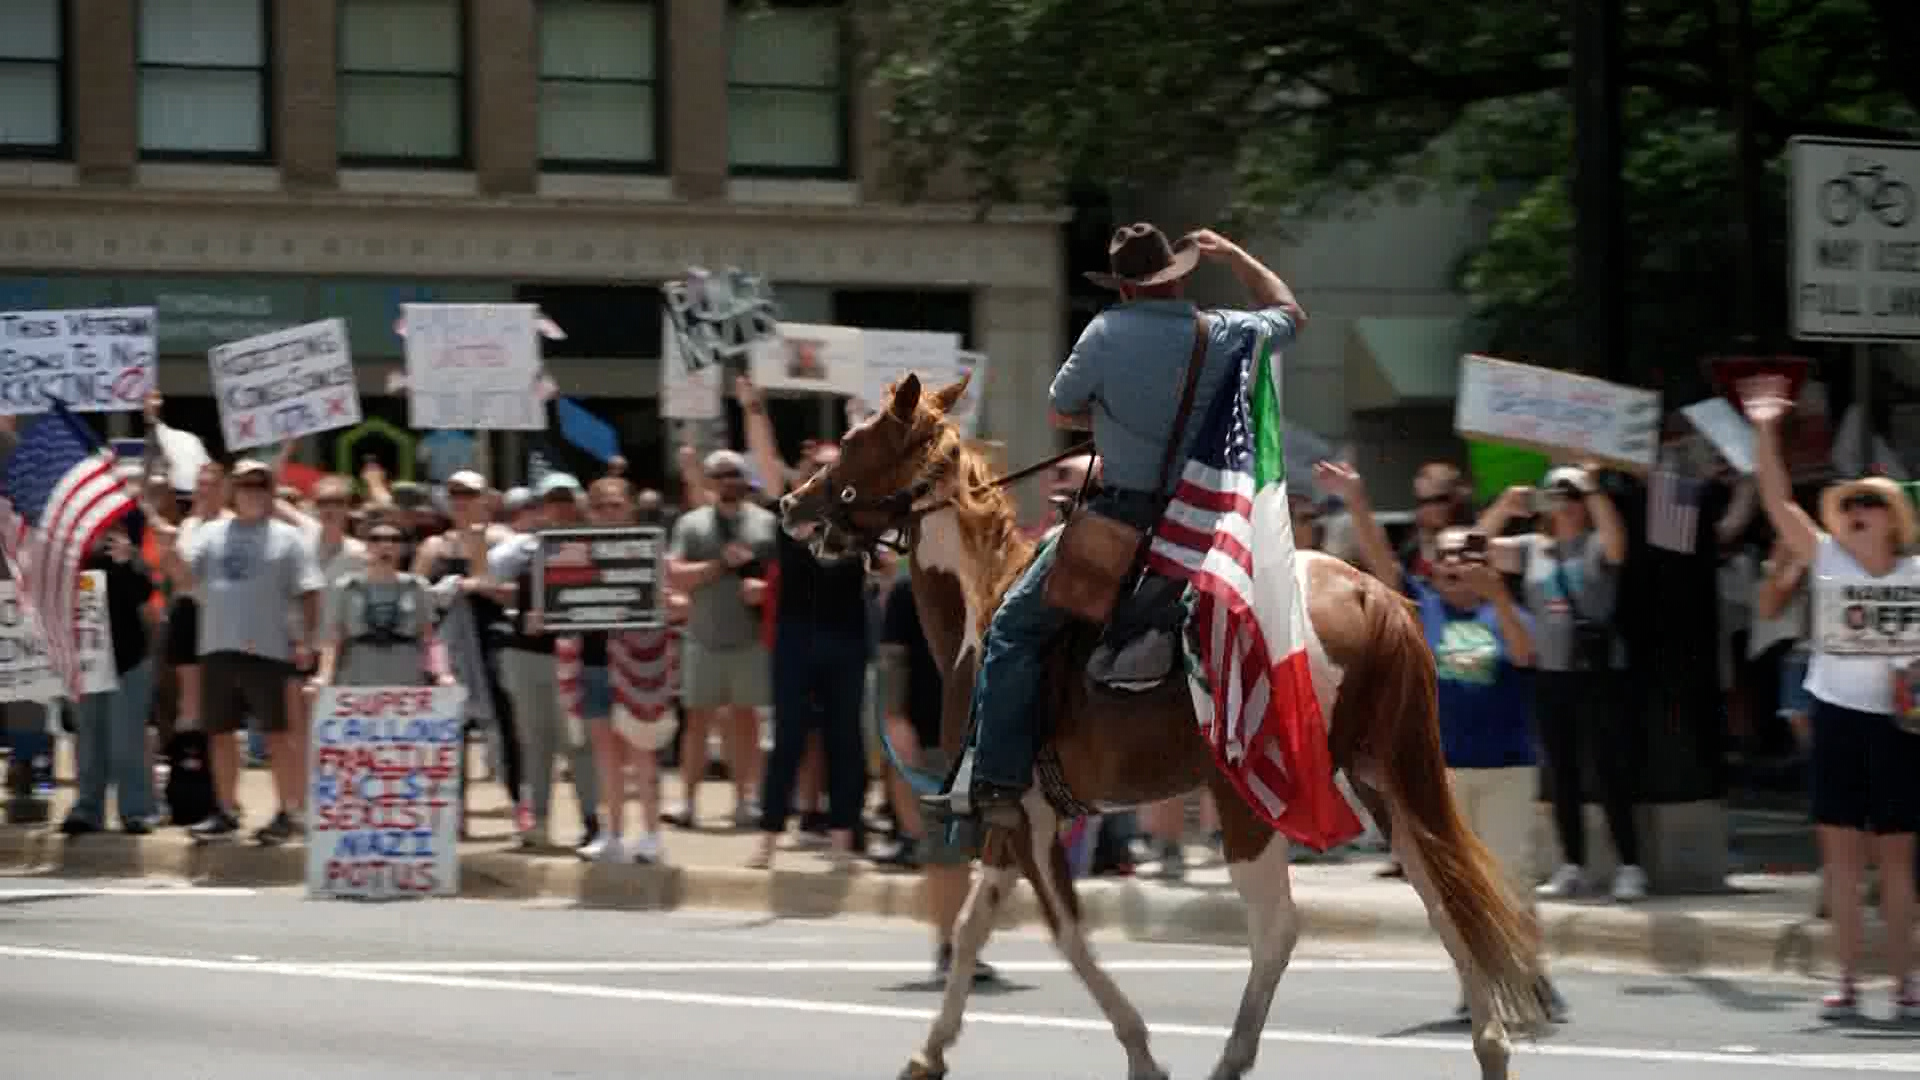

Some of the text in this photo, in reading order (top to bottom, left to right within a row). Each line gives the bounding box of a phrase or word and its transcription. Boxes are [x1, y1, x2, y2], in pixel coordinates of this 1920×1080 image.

[336, 691, 433, 716] SUPER
[319, 719, 462, 744] CALLOUS
[319, 745, 452, 772] FRAGILE
[318, 773, 450, 801] RACIST
[318, 801, 449, 830] SEXIST
[337, 831, 434, 857] NAZI
[326, 860, 434, 892] POTUS
